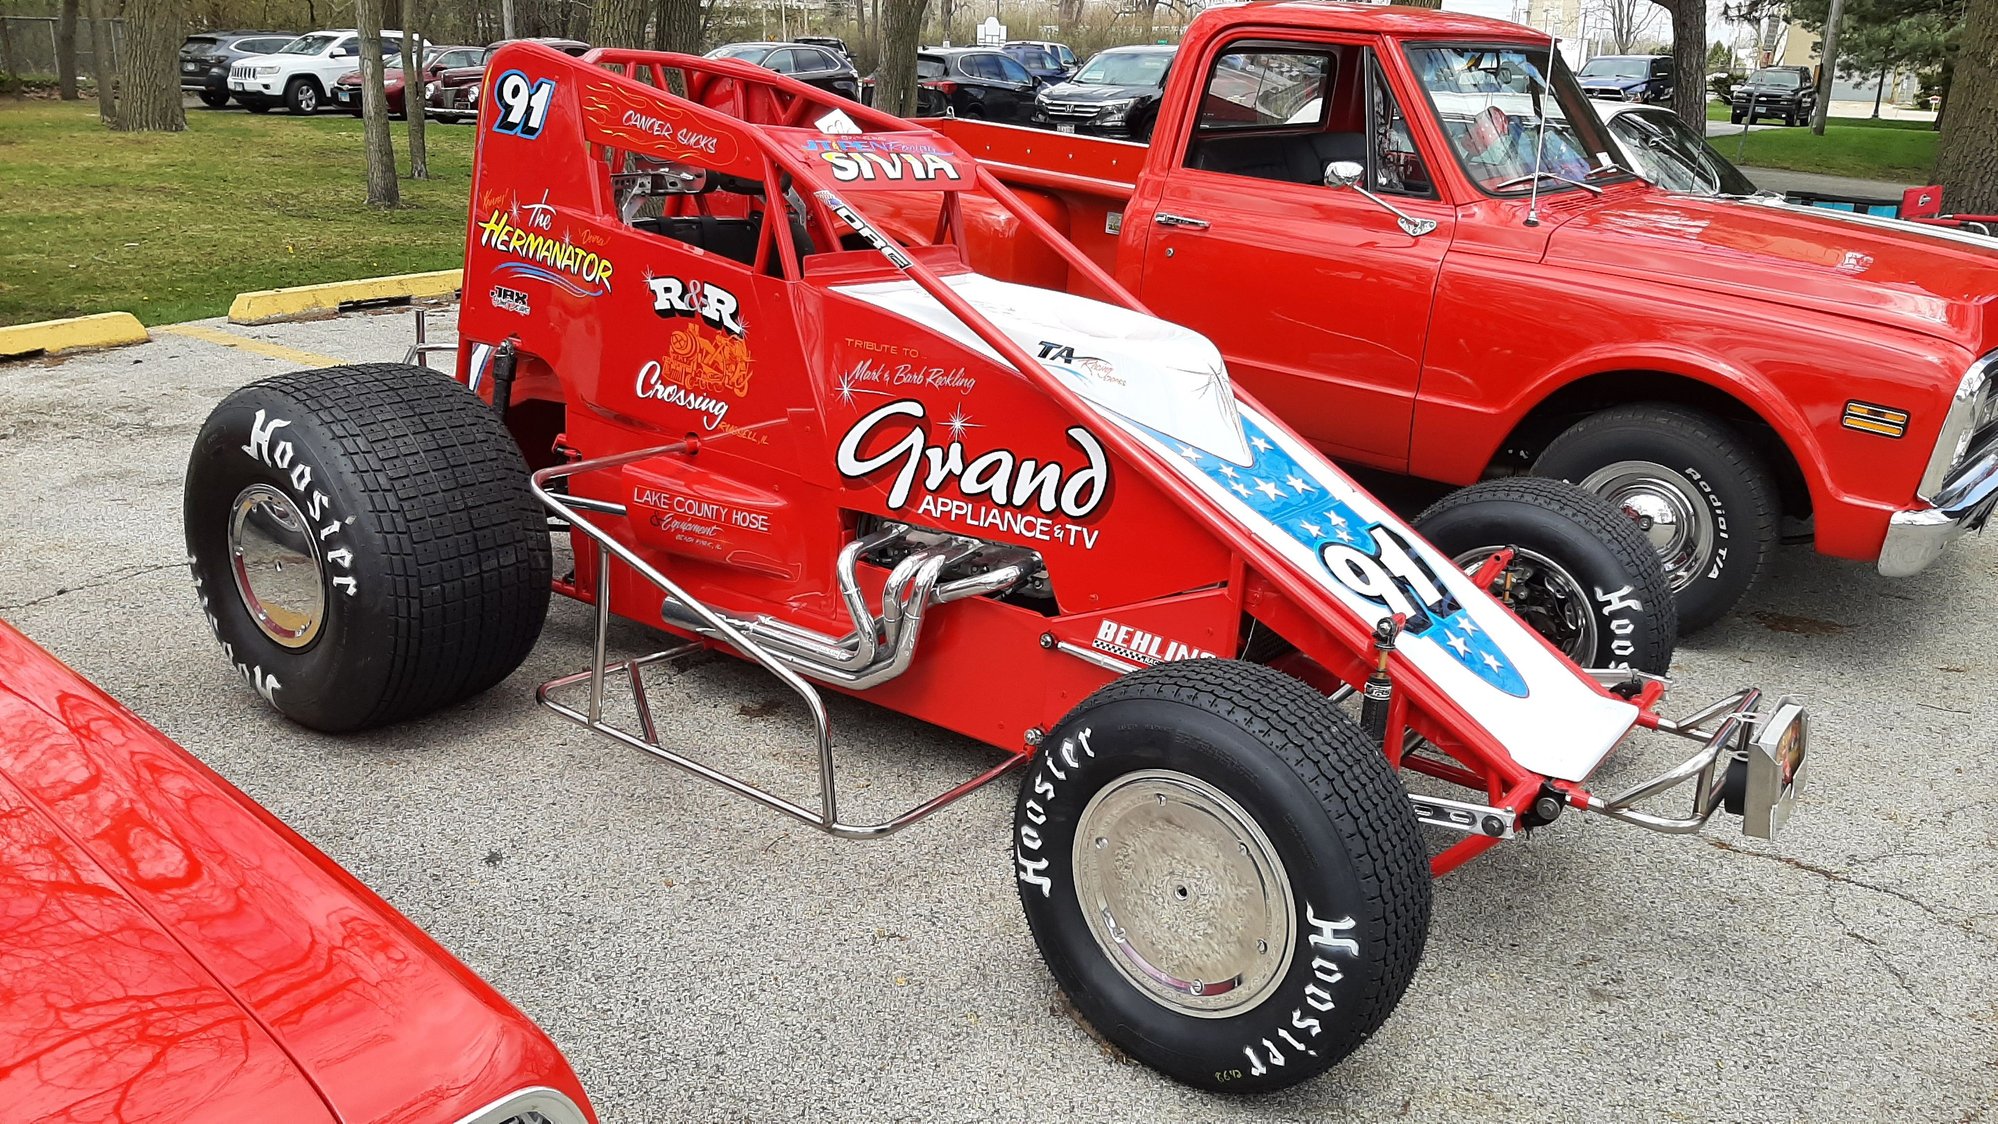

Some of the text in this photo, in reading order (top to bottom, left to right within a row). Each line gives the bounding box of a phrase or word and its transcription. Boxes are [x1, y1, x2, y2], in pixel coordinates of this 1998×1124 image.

[495, 70, 555, 138] 91
[623, 110, 717, 154] CANCER SUCKS
[522, 188, 557, 230] The
[477, 209, 614, 294] HERMANATOR
[650, 276, 744, 337] R&R
[845, 338, 898, 355] TRIBUTE
[849, 359, 881, 383] Mark
[894, 364, 925, 386] Barb
[1037, 340, 1075, 364] TA
[636, 361, 729, 430] Crossing
[835, 398, 1109, 518] Grand
[241, 408, 358, 597] Hoosier
[633, 487, 769, 532] LAKE COUNTY HOSE
[918, 495, 1052, 541] APPLIANCE
[1065, 523, 1099, 550] TV
[1685, 467, 1729, 580] Radial T/A
[1317, 523, 1462, 635] 91
[1096, 619, 1216, 661] BEHLIN
[1017, 727, 1096, 898] Hoosier
[1244, 900, 1360, 1077] Hoosier
